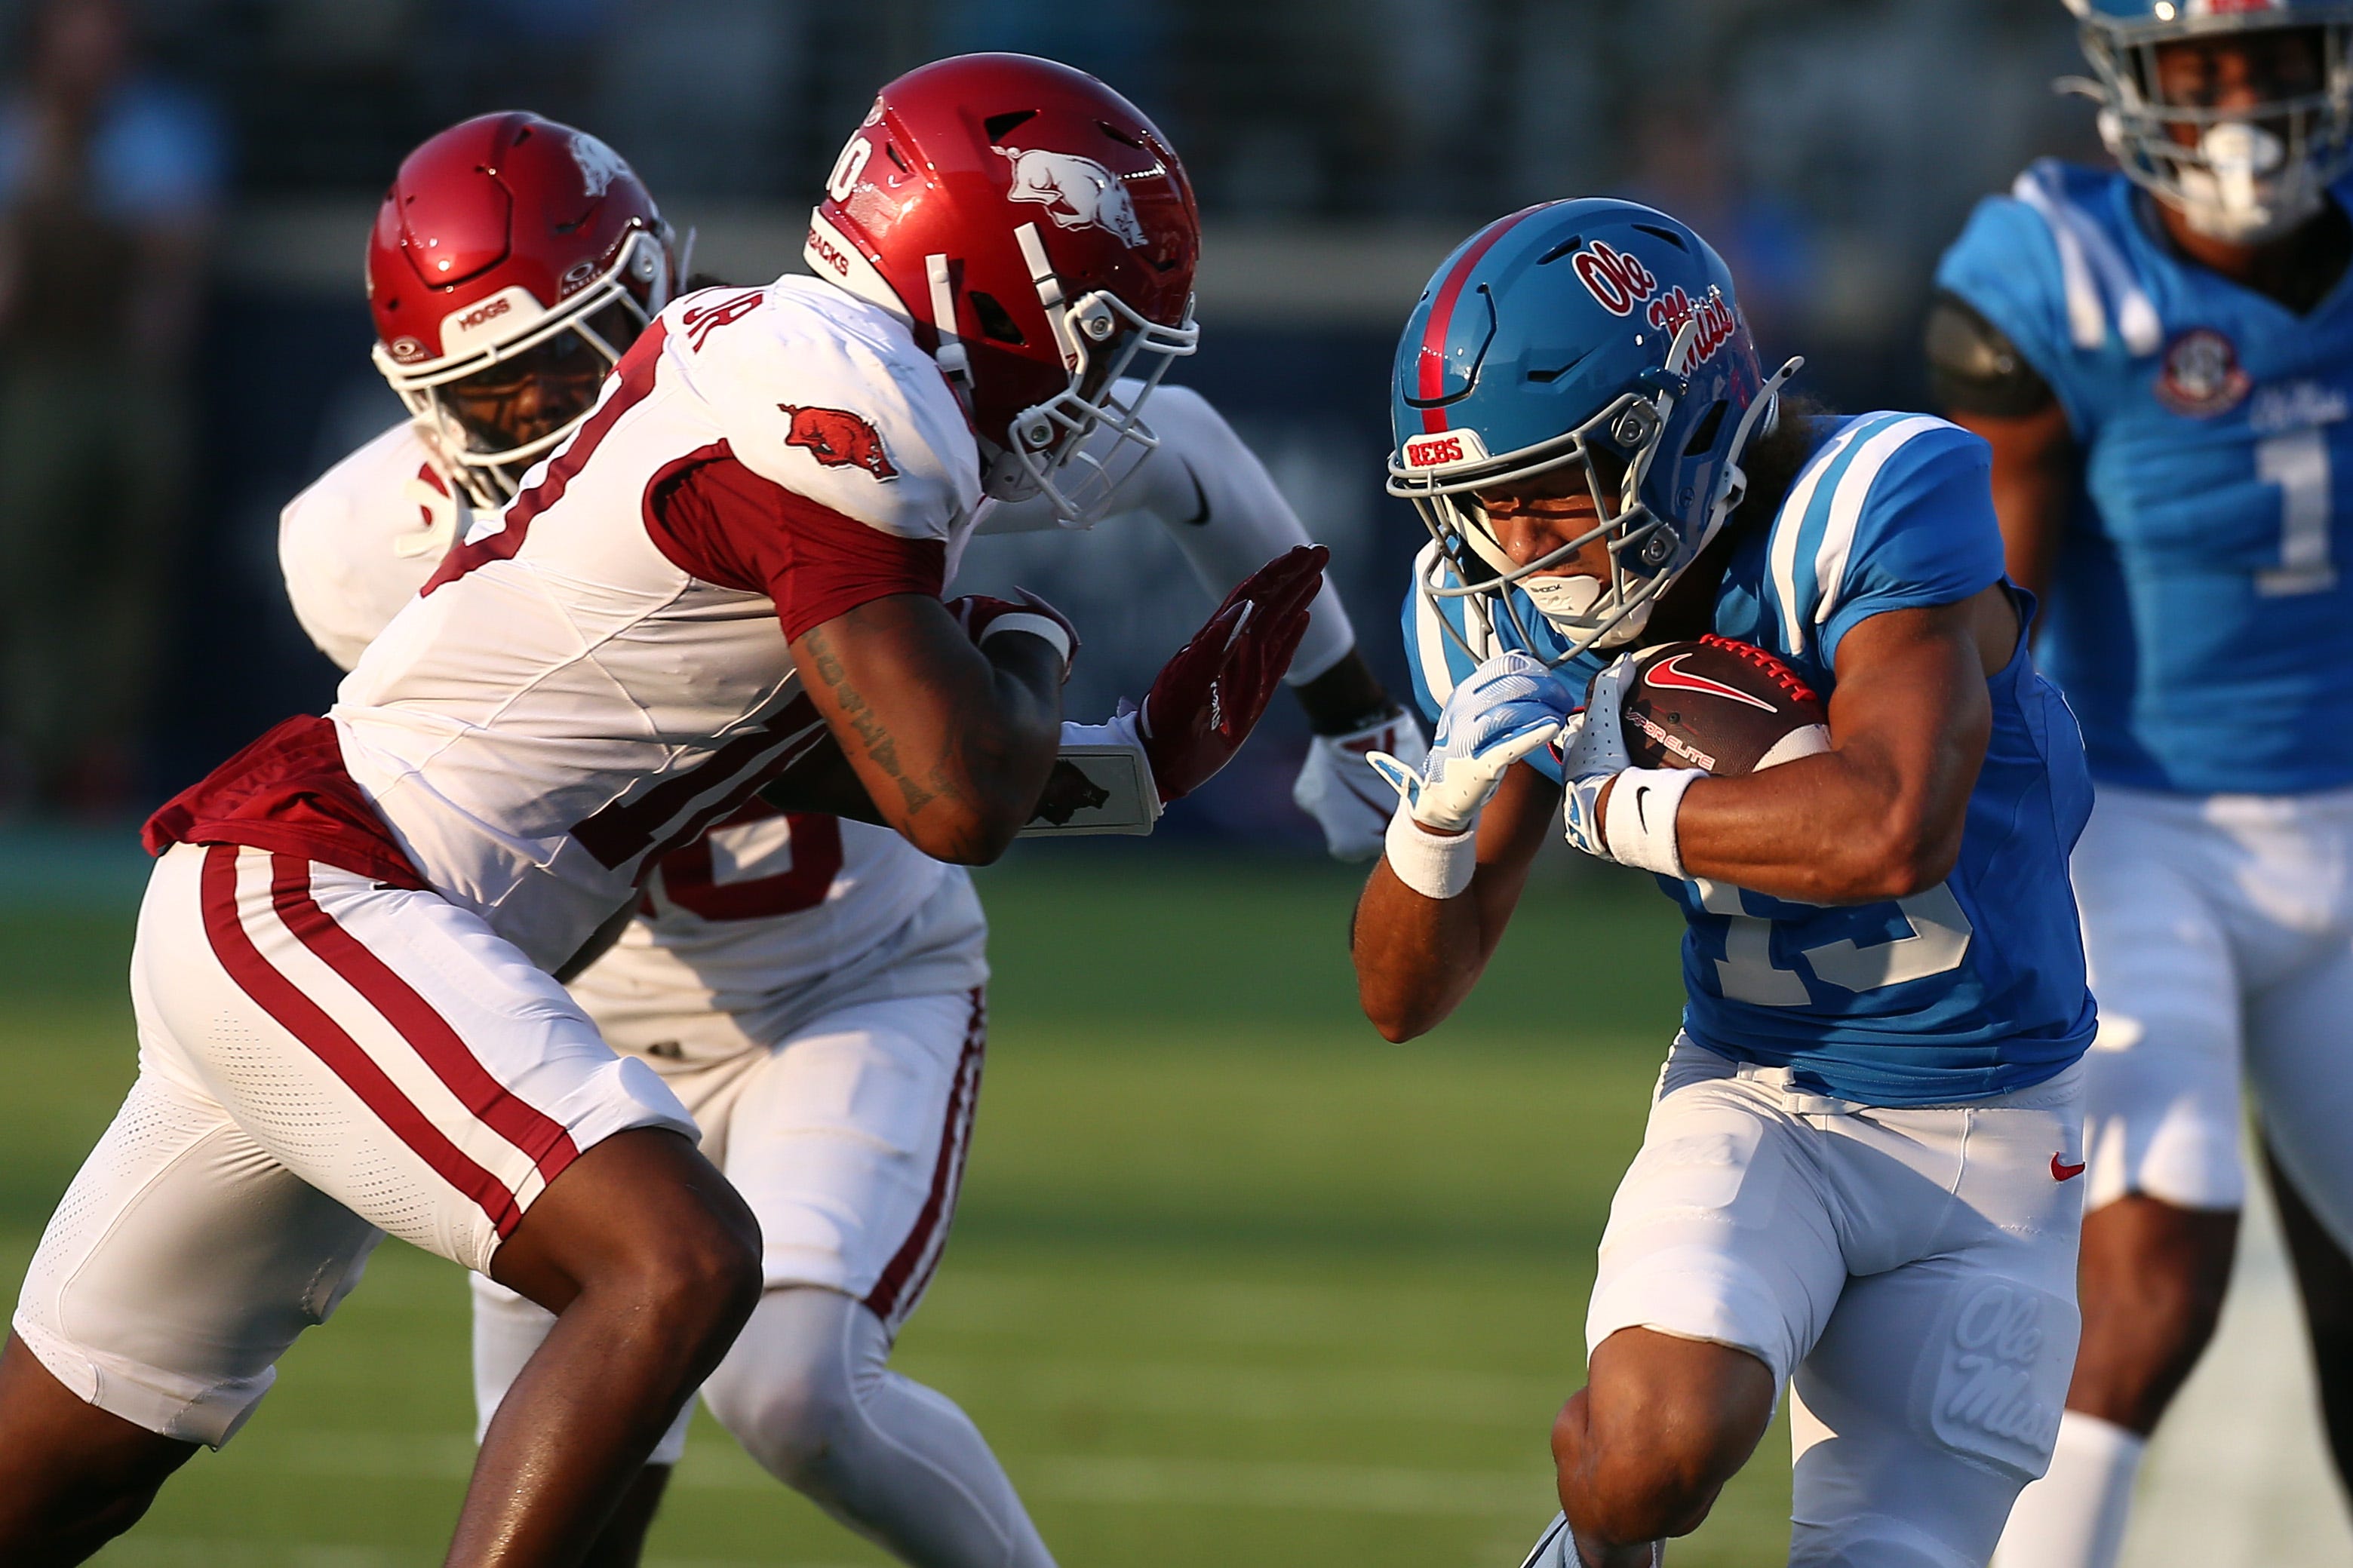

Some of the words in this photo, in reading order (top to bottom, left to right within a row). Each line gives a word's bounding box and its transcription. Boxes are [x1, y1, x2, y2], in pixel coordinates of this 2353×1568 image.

[1572, 240, 1657, 317] Ole
[1407, 437, 1464, 467] REBS
[1625, 707, 1666, 744] VAPOR
[1663, 735, 1716, 772] ELITE
